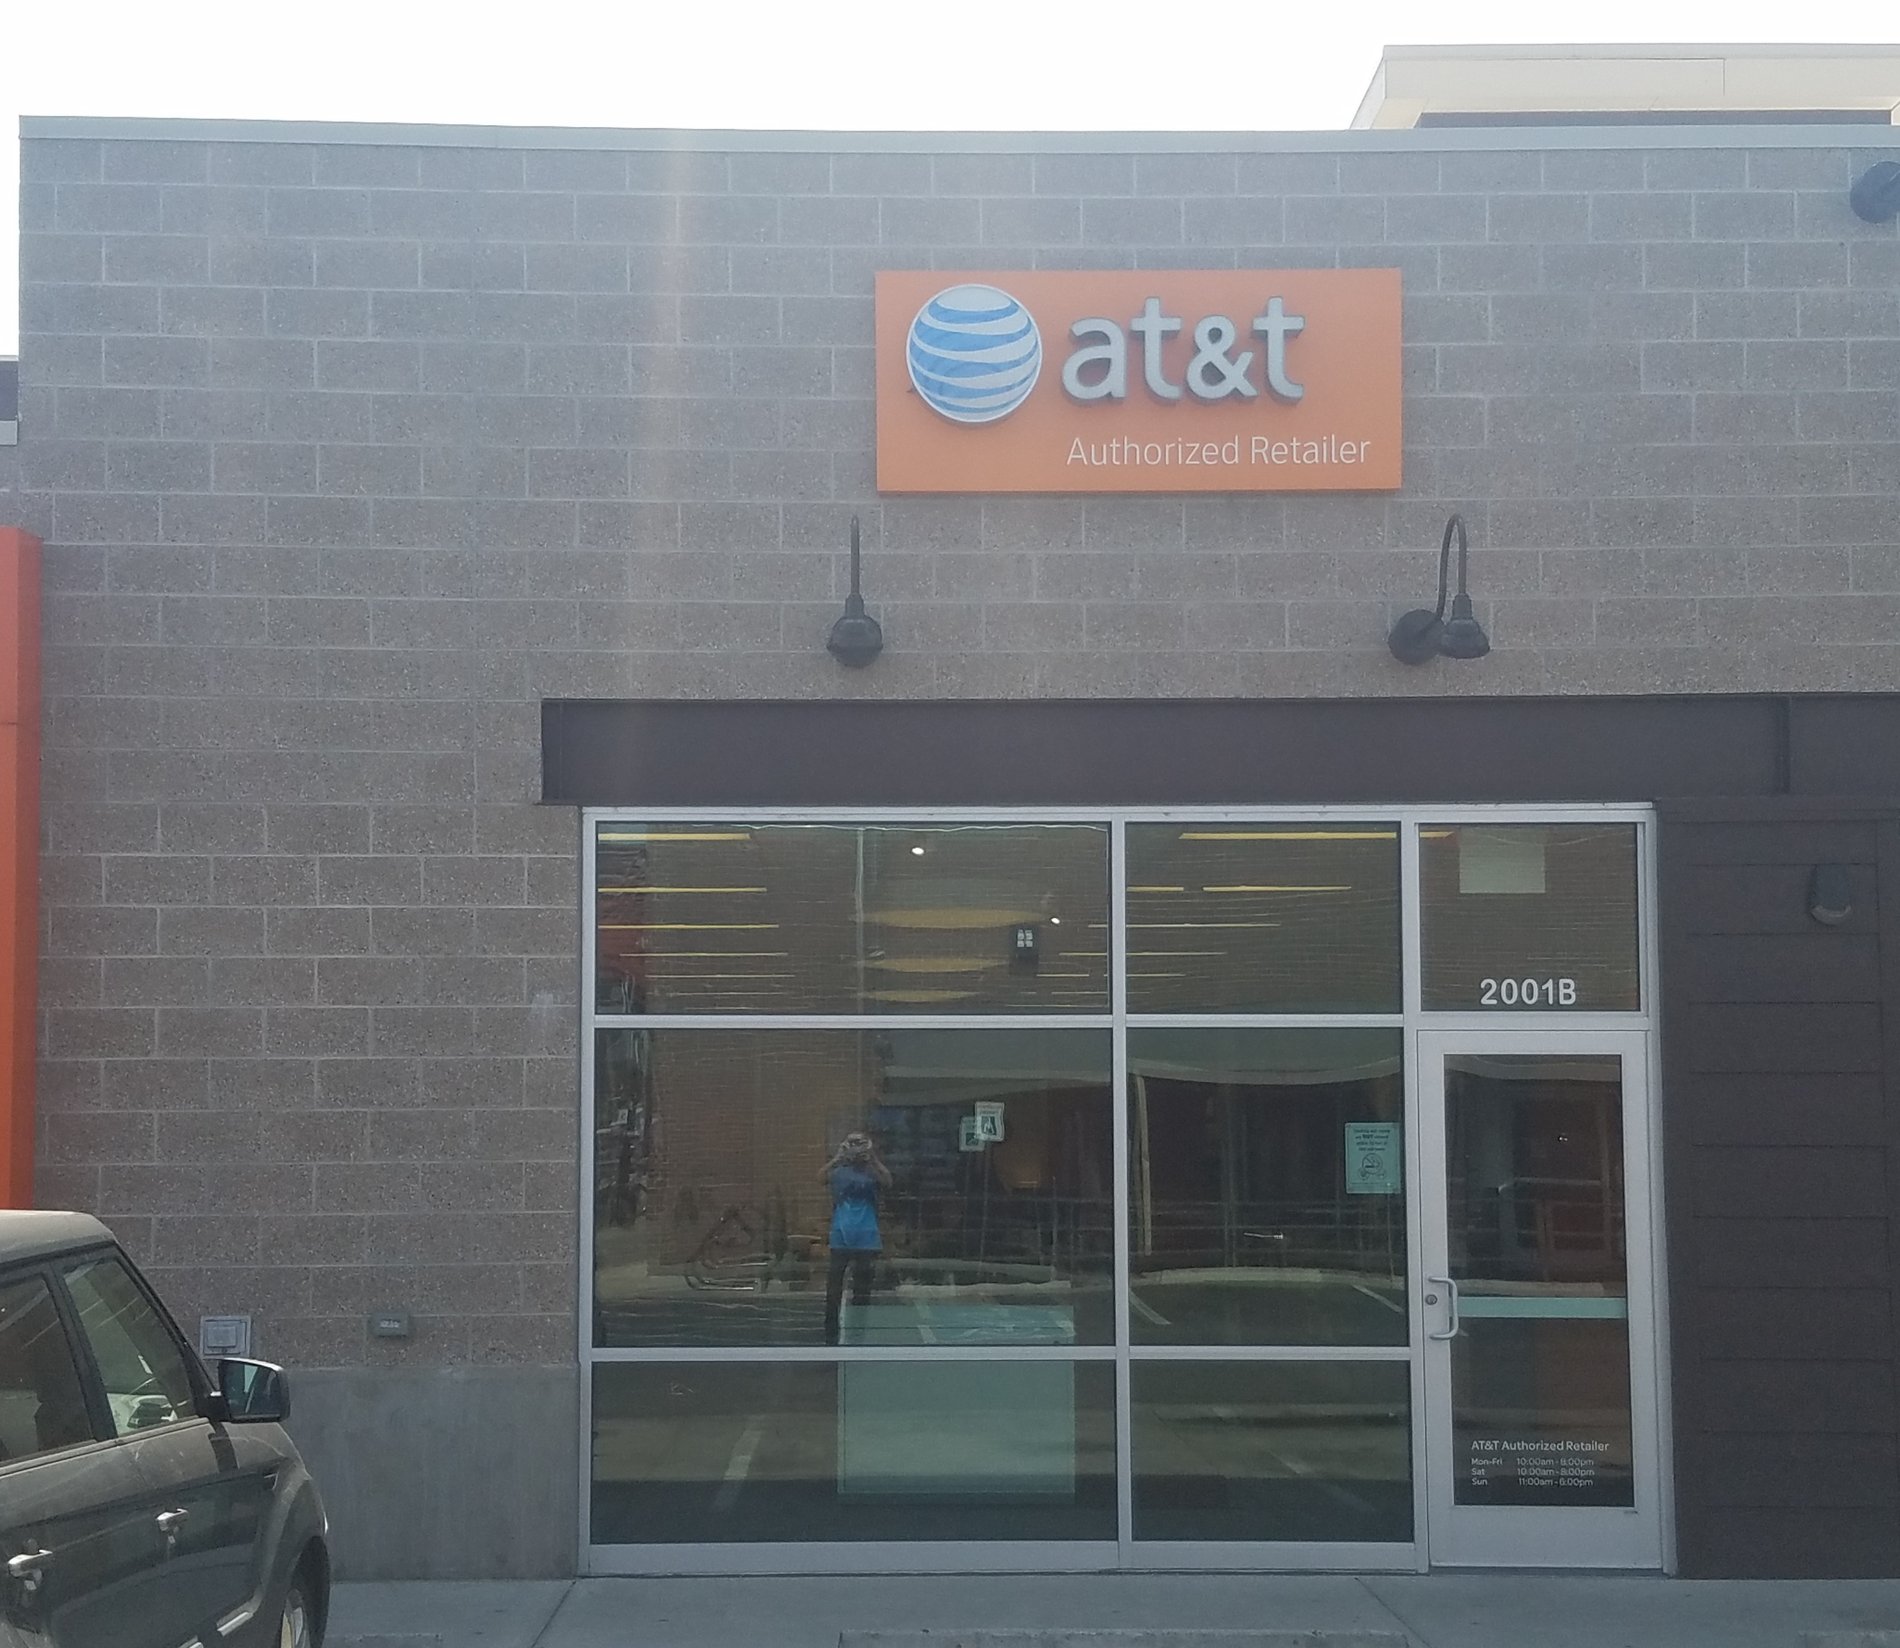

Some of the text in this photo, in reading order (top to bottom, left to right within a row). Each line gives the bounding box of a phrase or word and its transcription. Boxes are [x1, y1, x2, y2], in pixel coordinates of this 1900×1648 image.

[1061, 295, 1306, 401] at&t
[1066, 434, 1371, 466] Authorized Retailer
[1480, 978, 1577, 1005] 2001B
[1471, 1440, 1610, 1452] AT&T Authorized Retailer
[1471, 1468, 1485, 1476] Sat
[1471, 1478, 1488, 1486] Sun
